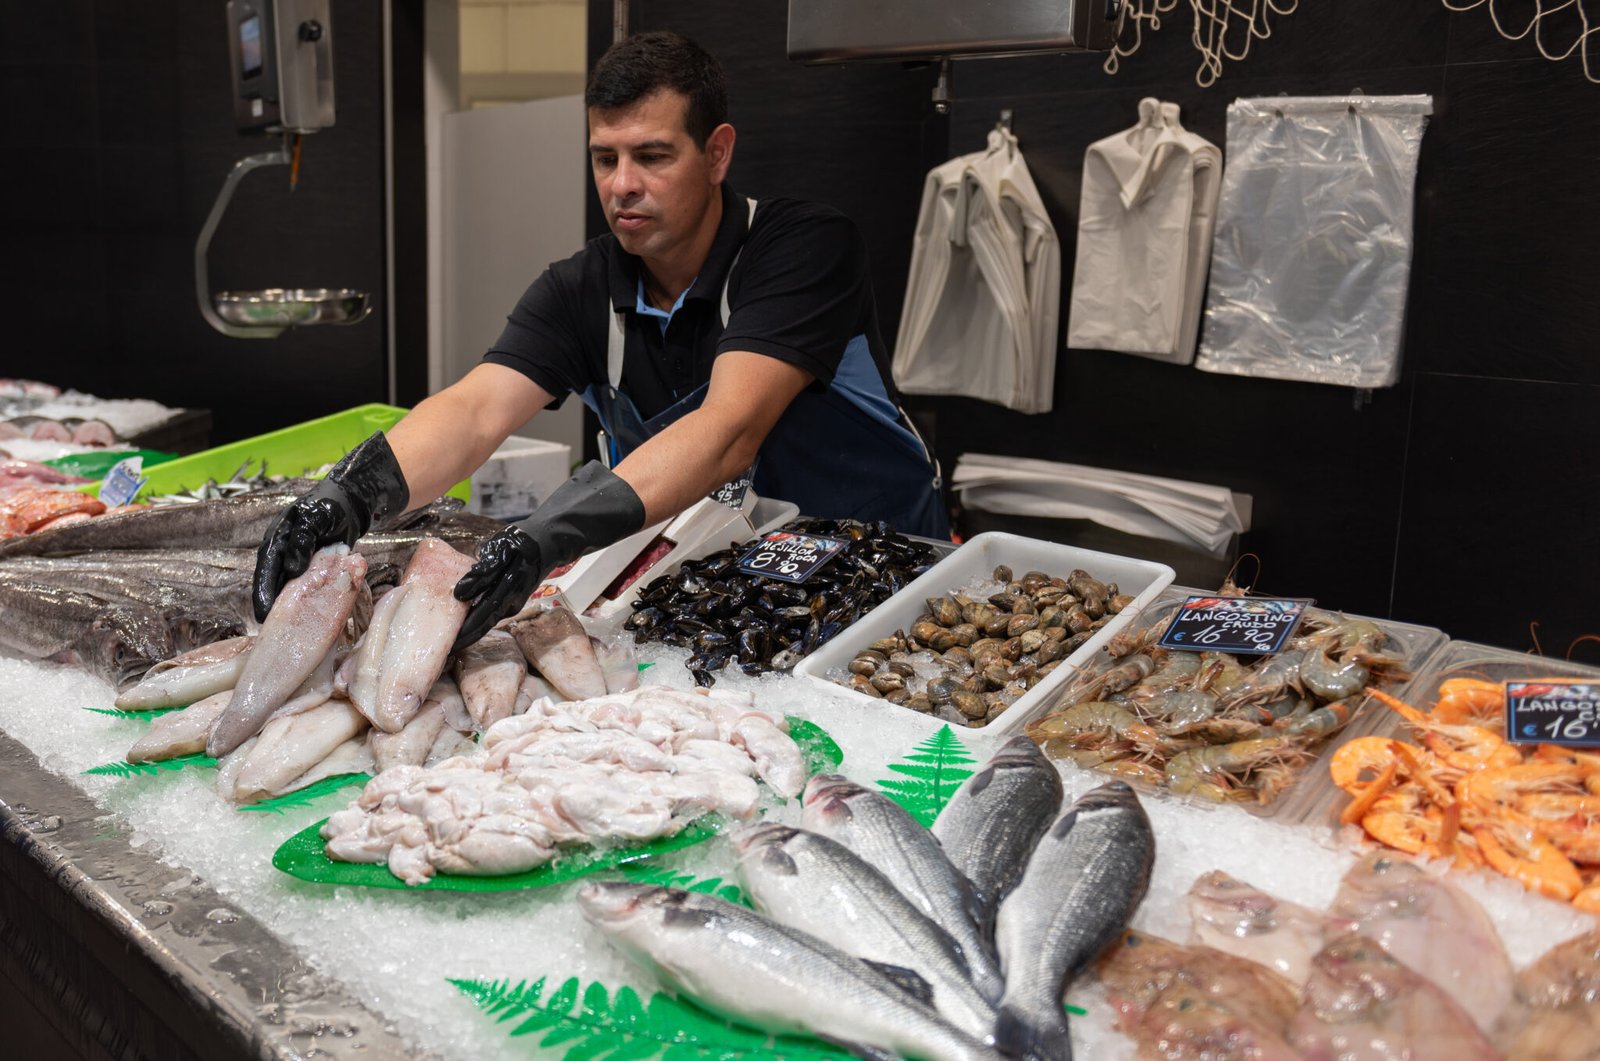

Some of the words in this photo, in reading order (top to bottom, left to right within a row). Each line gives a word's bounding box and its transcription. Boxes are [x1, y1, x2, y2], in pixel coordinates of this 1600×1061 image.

[787, 553, 818, 563] ROCA
[1181, 610, 1295, 622] LANGOSTINO
[1222, 621, 1277, 629] CRUDO
[1578, 711, 1600, 721] C
[1522, 723, 1537, 737] €
